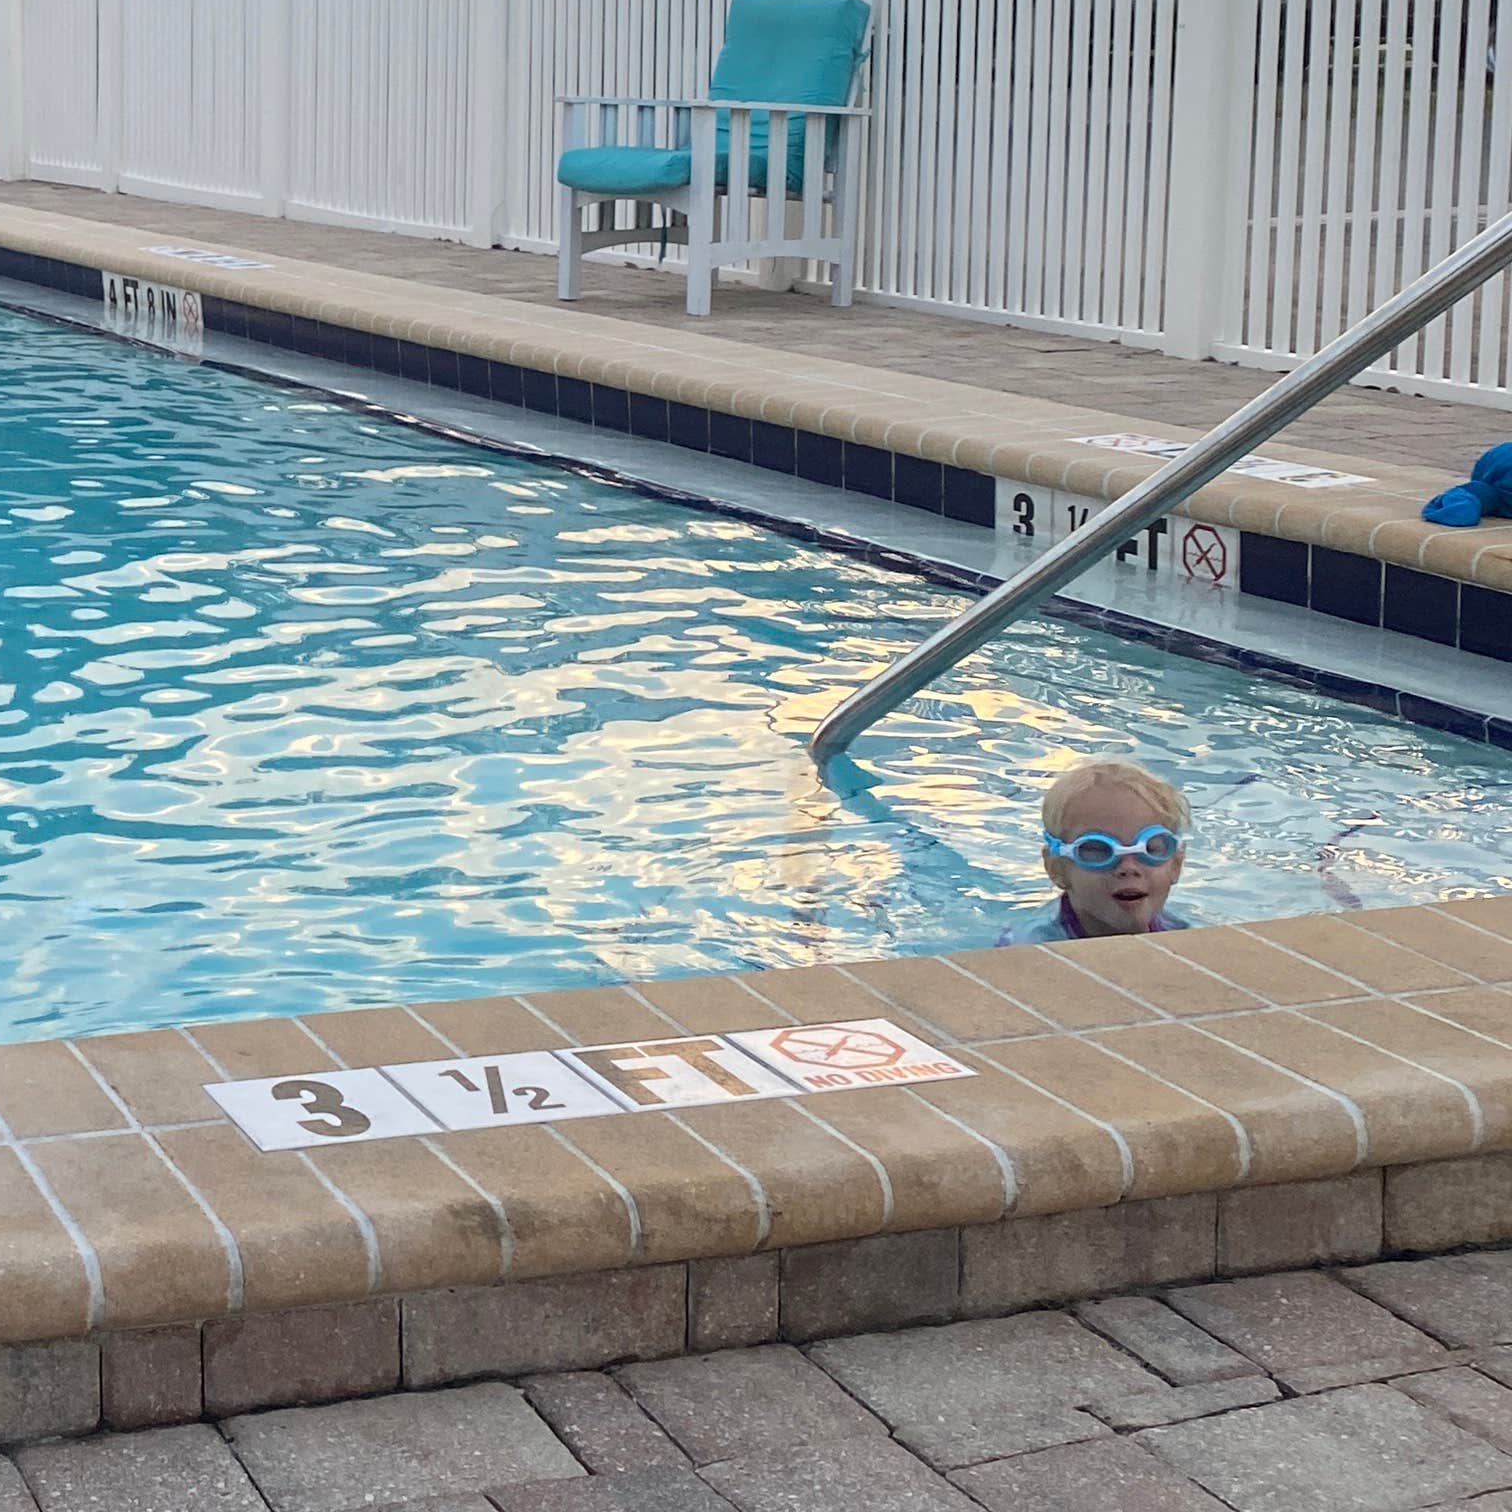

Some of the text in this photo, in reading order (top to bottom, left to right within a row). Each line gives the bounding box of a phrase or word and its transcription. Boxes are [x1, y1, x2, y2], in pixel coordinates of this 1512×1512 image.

[122, 277, 139, 311] FT
[161, 289, 177, 321] IN
[1013, 492, 1034, 537] 3
[271, 1080, 371, 1137] 3
[571, 1039, 760, 1106] FT
[803, 1061, 963, 1089] NO DIVING
